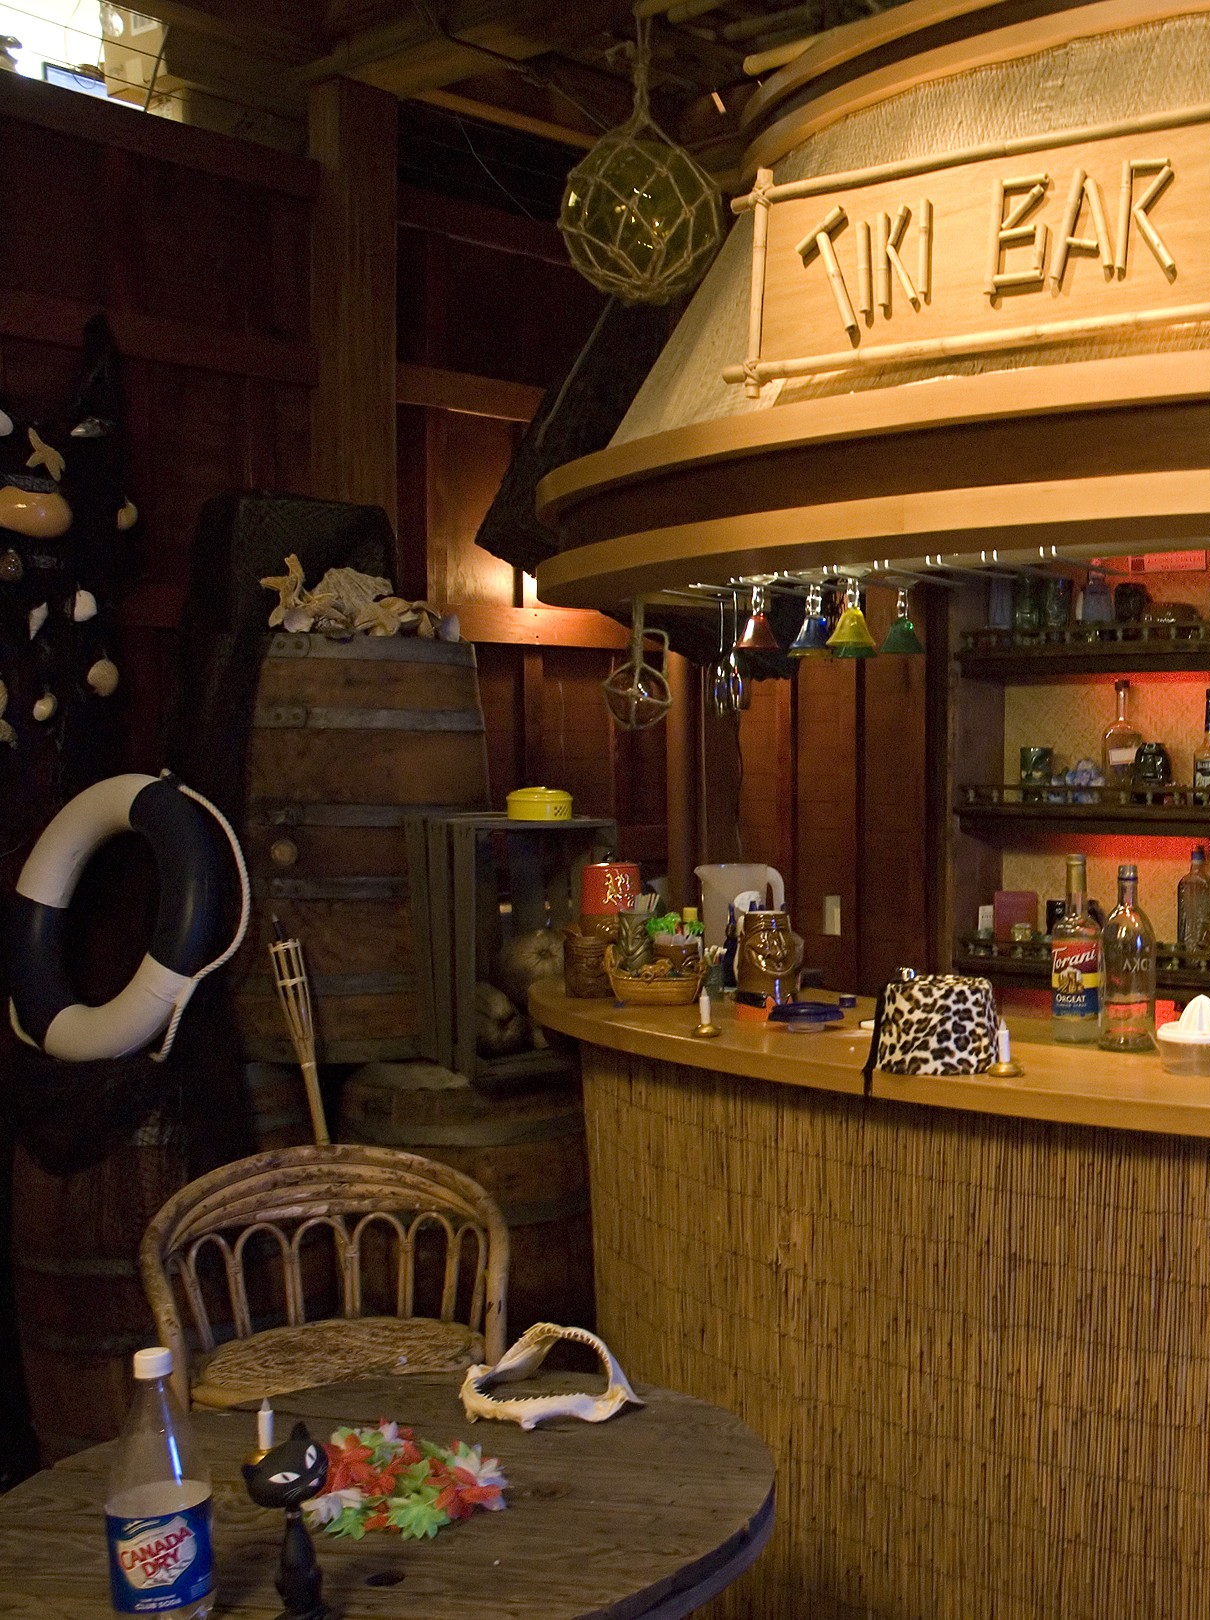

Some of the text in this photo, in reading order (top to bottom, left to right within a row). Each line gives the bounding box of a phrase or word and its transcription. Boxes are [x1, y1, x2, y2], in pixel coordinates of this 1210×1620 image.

[796, 158, 1175, 334] TIKI BAR
[1052, 944, 1096, 974] Torani
[1055, 993, 1087, 1003] ORGEAT
[119, 1526, 193, 1571] CANADA
[142, 1547, 179, 1577] DRY
